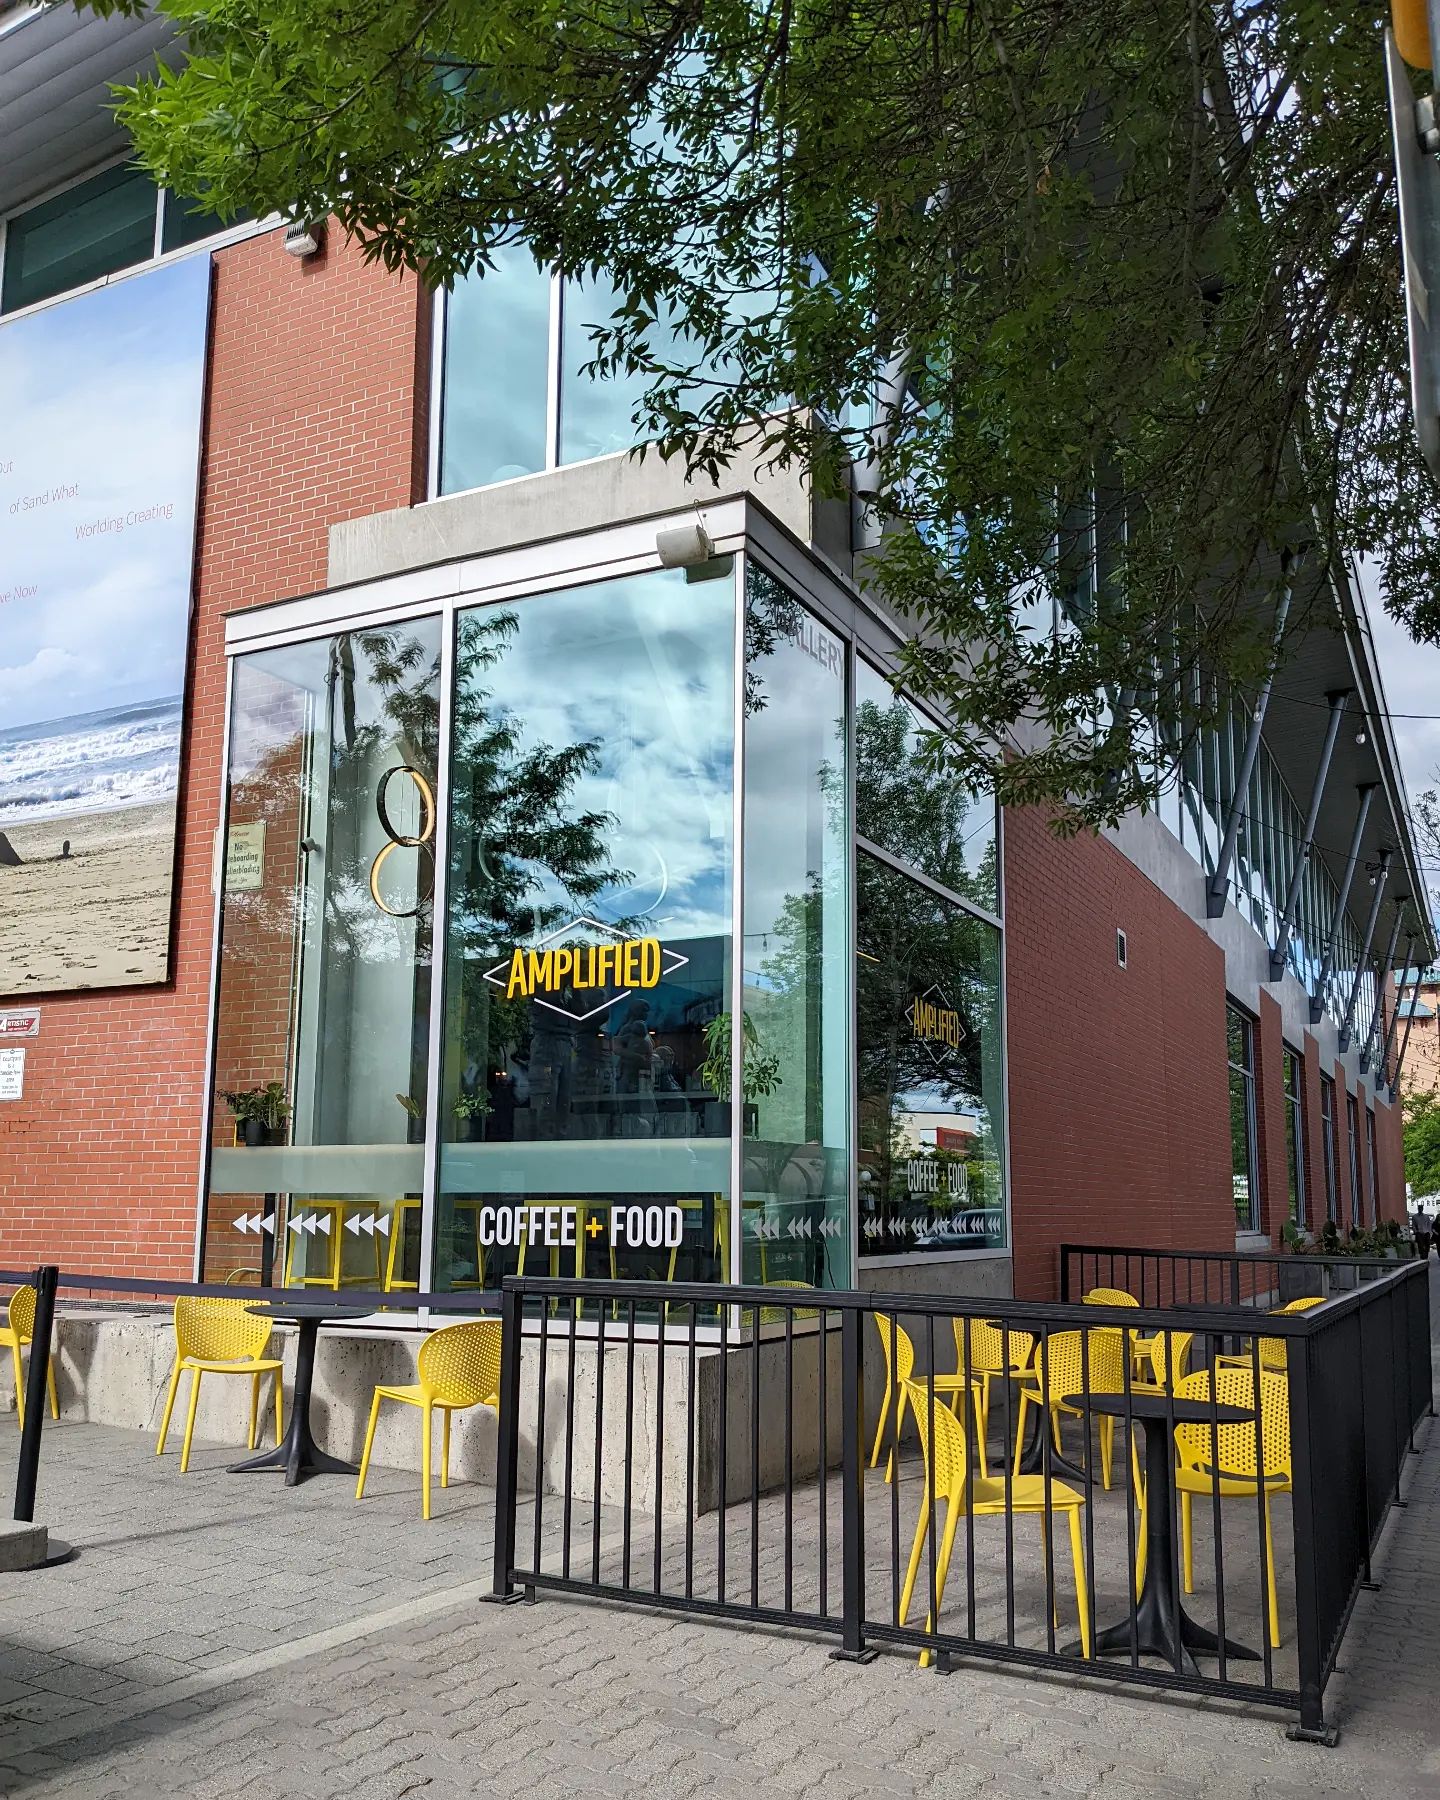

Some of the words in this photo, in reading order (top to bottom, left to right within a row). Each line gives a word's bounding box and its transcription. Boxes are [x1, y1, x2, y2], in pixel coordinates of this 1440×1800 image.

[9, 497, 20, 514] of
[22, 490, 49, 511] Sand
[52, 483, 79, 501] What
[75, 517, 124, 540] Worlding
[126, 503, 174, 526] Creating
[14, 585, 38, 600] Now
[507, 937, 661, 999] AMPLIFIED
[913, 995, 959, 1049] AMPLIFIED
[907, 1158, 940, 1192] COFFEE
[948, 1163, 968, 1193] FOOD
[479, 1205, 577, 1247] COFFEE
[585, 1216, 603, 1238] +
[610, 1205, 683, 1248] FOOD
